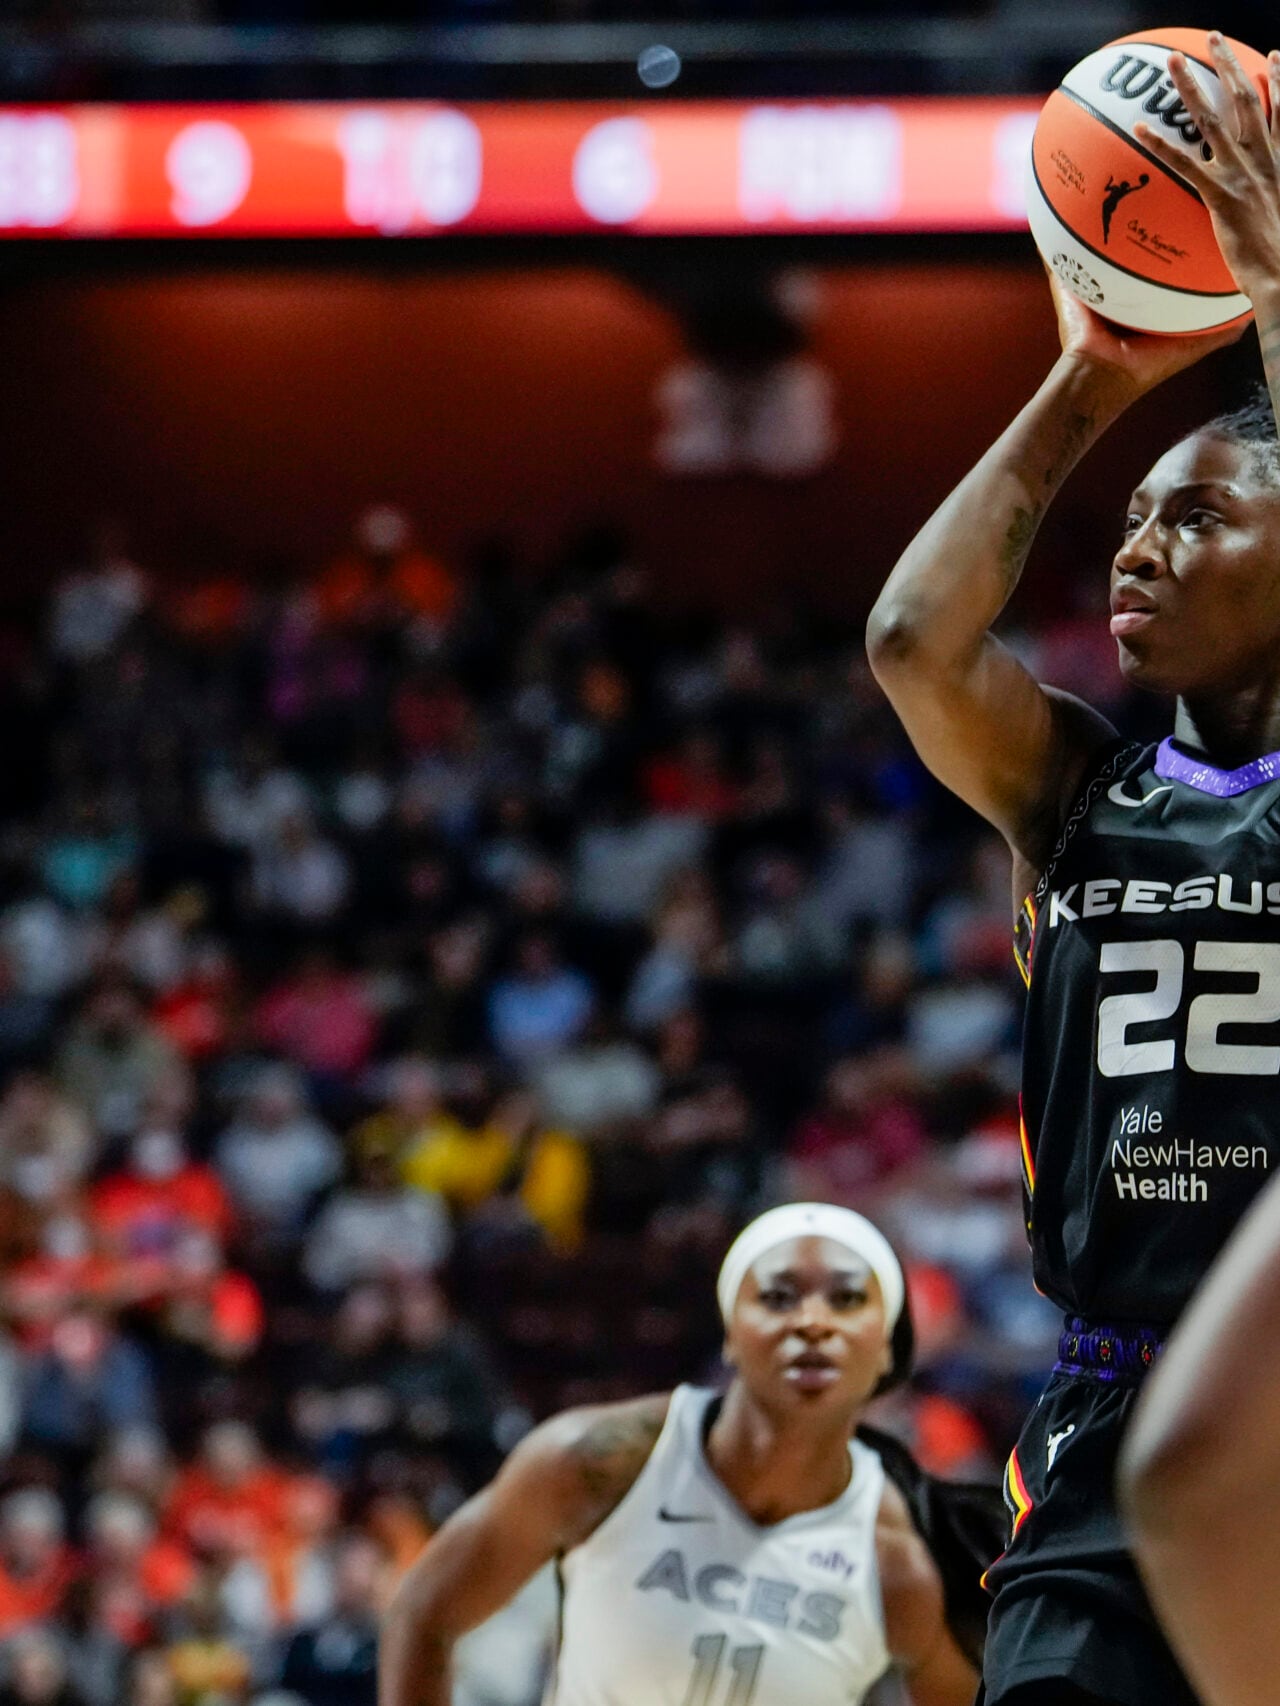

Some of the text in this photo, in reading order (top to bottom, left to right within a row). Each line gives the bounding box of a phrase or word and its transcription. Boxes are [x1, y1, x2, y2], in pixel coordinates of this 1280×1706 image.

[1101, 54, 1214, 162] Wils
[1119, 1105, 1163, 1135] Yale
[1114, 1172, 1208, 1202] Health
[635, 1548, 847, 1643] ACES
[683, 1632, 767, 1706] 11
